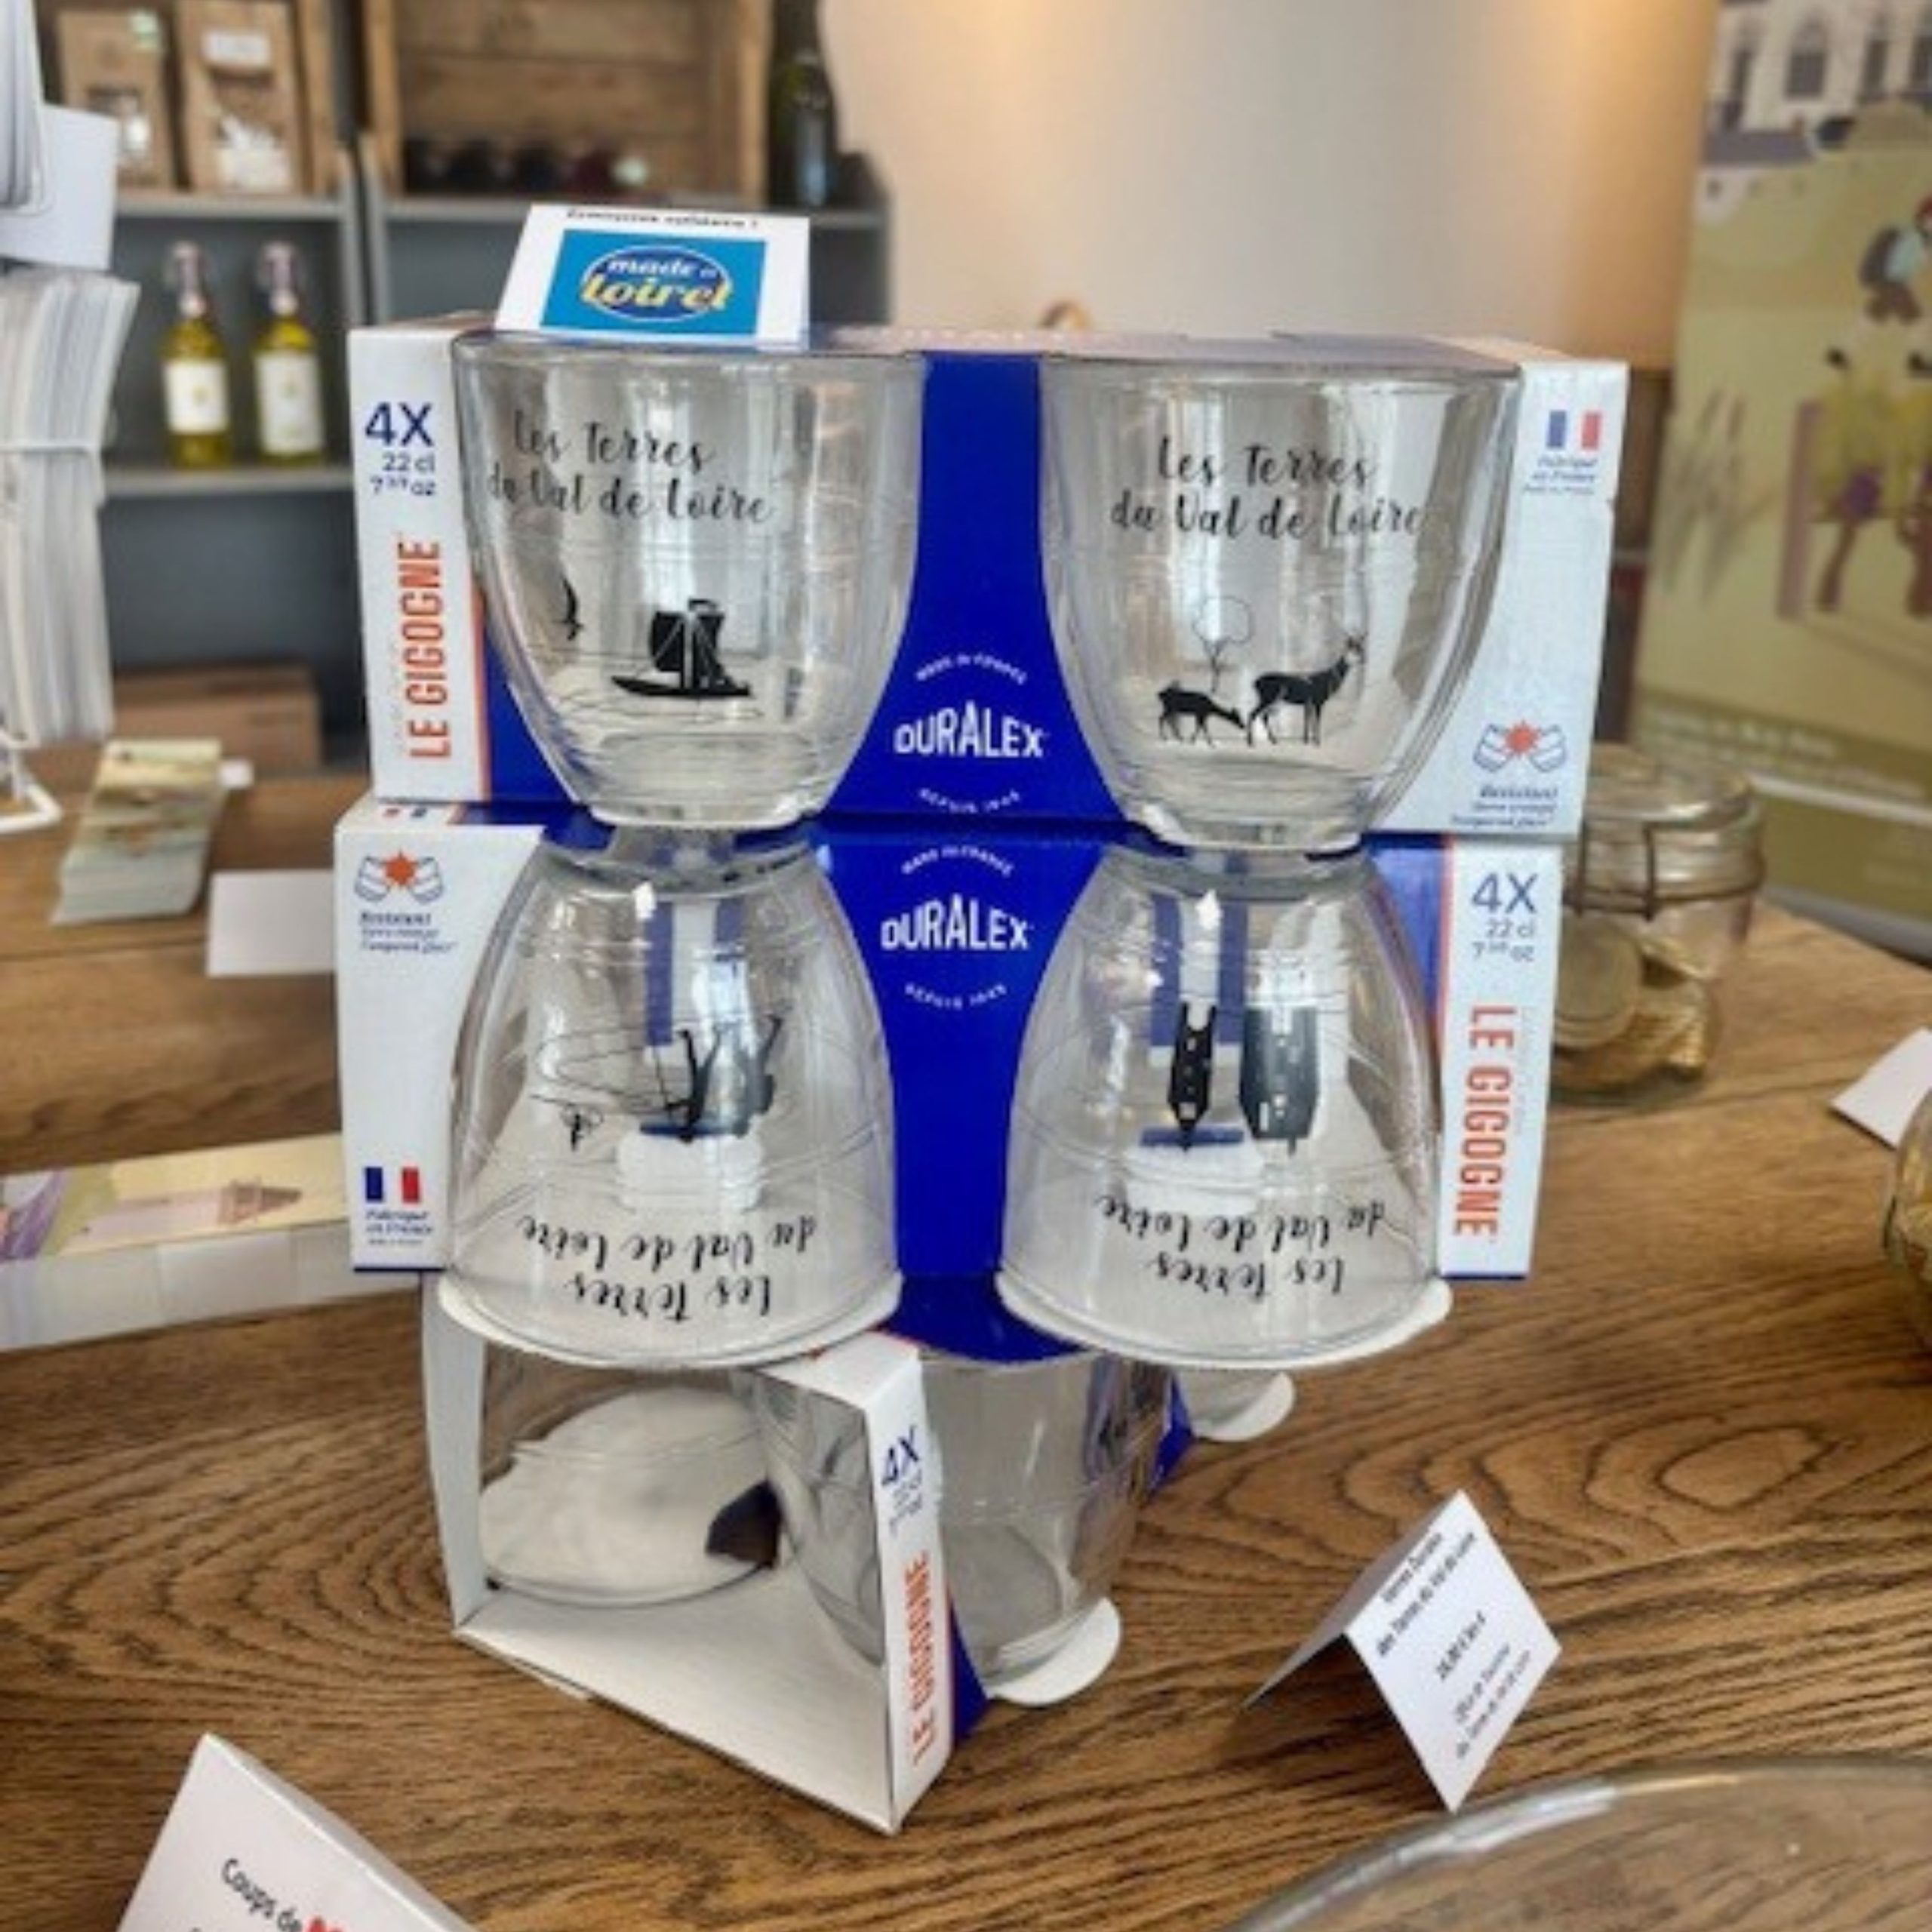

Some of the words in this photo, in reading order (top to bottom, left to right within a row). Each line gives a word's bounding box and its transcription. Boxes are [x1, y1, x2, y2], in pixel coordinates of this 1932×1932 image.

[365, 401, 434, 447] 4X
[585, 421, 714, 475] Terres
[1243, 444, 1377, 491] Terres
[599, 477, 655, 518] de
[1111, 488, 1158, 531] du
[1174, 493, 1245, 540] Val
[1258, 496, 1312, 540] de
[398, 540, 449, 707] GIGOGNE
[408, 719, 451, 759] LE
[894, 700, 1044, 758] DURALEX
[1471, 872, 1538, 915] 4X
[880, 893, 1031, 950] DURALEX
[1469, 1005, 1517, 1050] LE
[1453, 1066, 1514, 1238] GIGOGNE
[621, 1235, 675, 1273] de
[685, 1231, 754, 1274] Val
[767, 1214, 817, 1254] du
[1204, 1215, 1257, 1253] de
[565, 1272, 691, 1323] Terres
[1148, 1251, 1269, 1303] Terres
[222, 1857, 277, 1918] Coups
